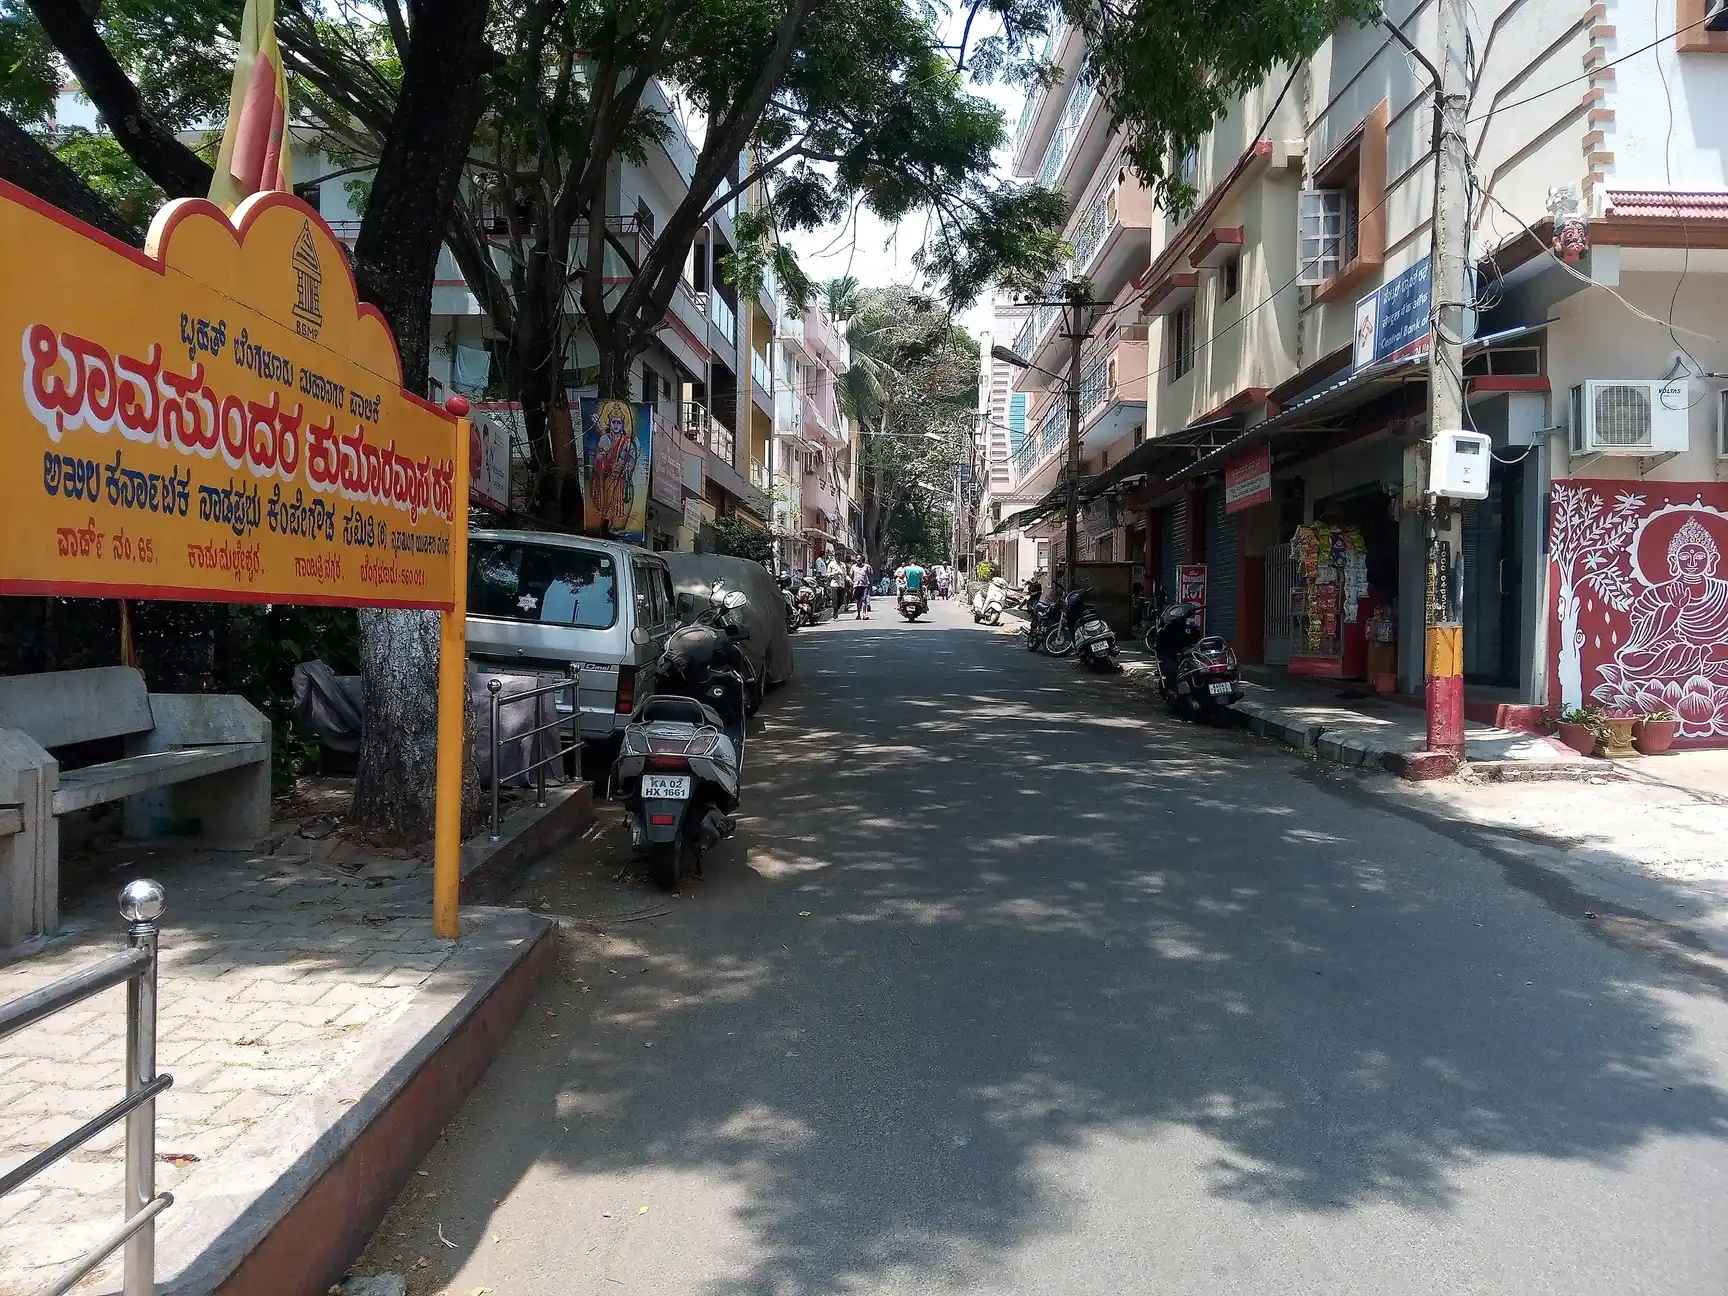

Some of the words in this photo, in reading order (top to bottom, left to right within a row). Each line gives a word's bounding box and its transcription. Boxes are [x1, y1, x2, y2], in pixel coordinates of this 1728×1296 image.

[1403, 317, 1421, 337] Bank
[233, 327, 294, 387] ಬೆಂಗಳೂರು
[299, 368, 345, 409] ಮಹಾನಗರ
[350, 391, 381, 424] ಪಾಲಿಕೆ
[43, 451, 100, 502] ಅಖಿಲ
[105, 449, 191, 516] ಕರ್ನಾಟಕ
[198, 477, 261, 536] ನಾಡಪ್ರಭು
[268, 483, 336, 542] ಕೆಂಪೇಗೌಡ
[342, 505, 375, 547] ಸಮಿತಿ
[645, 788, 661, 797] HX
[663, 788, 686, 797] 1661
[650, 780, 667, 788] KA
[669, 780, 682, 788] 02
